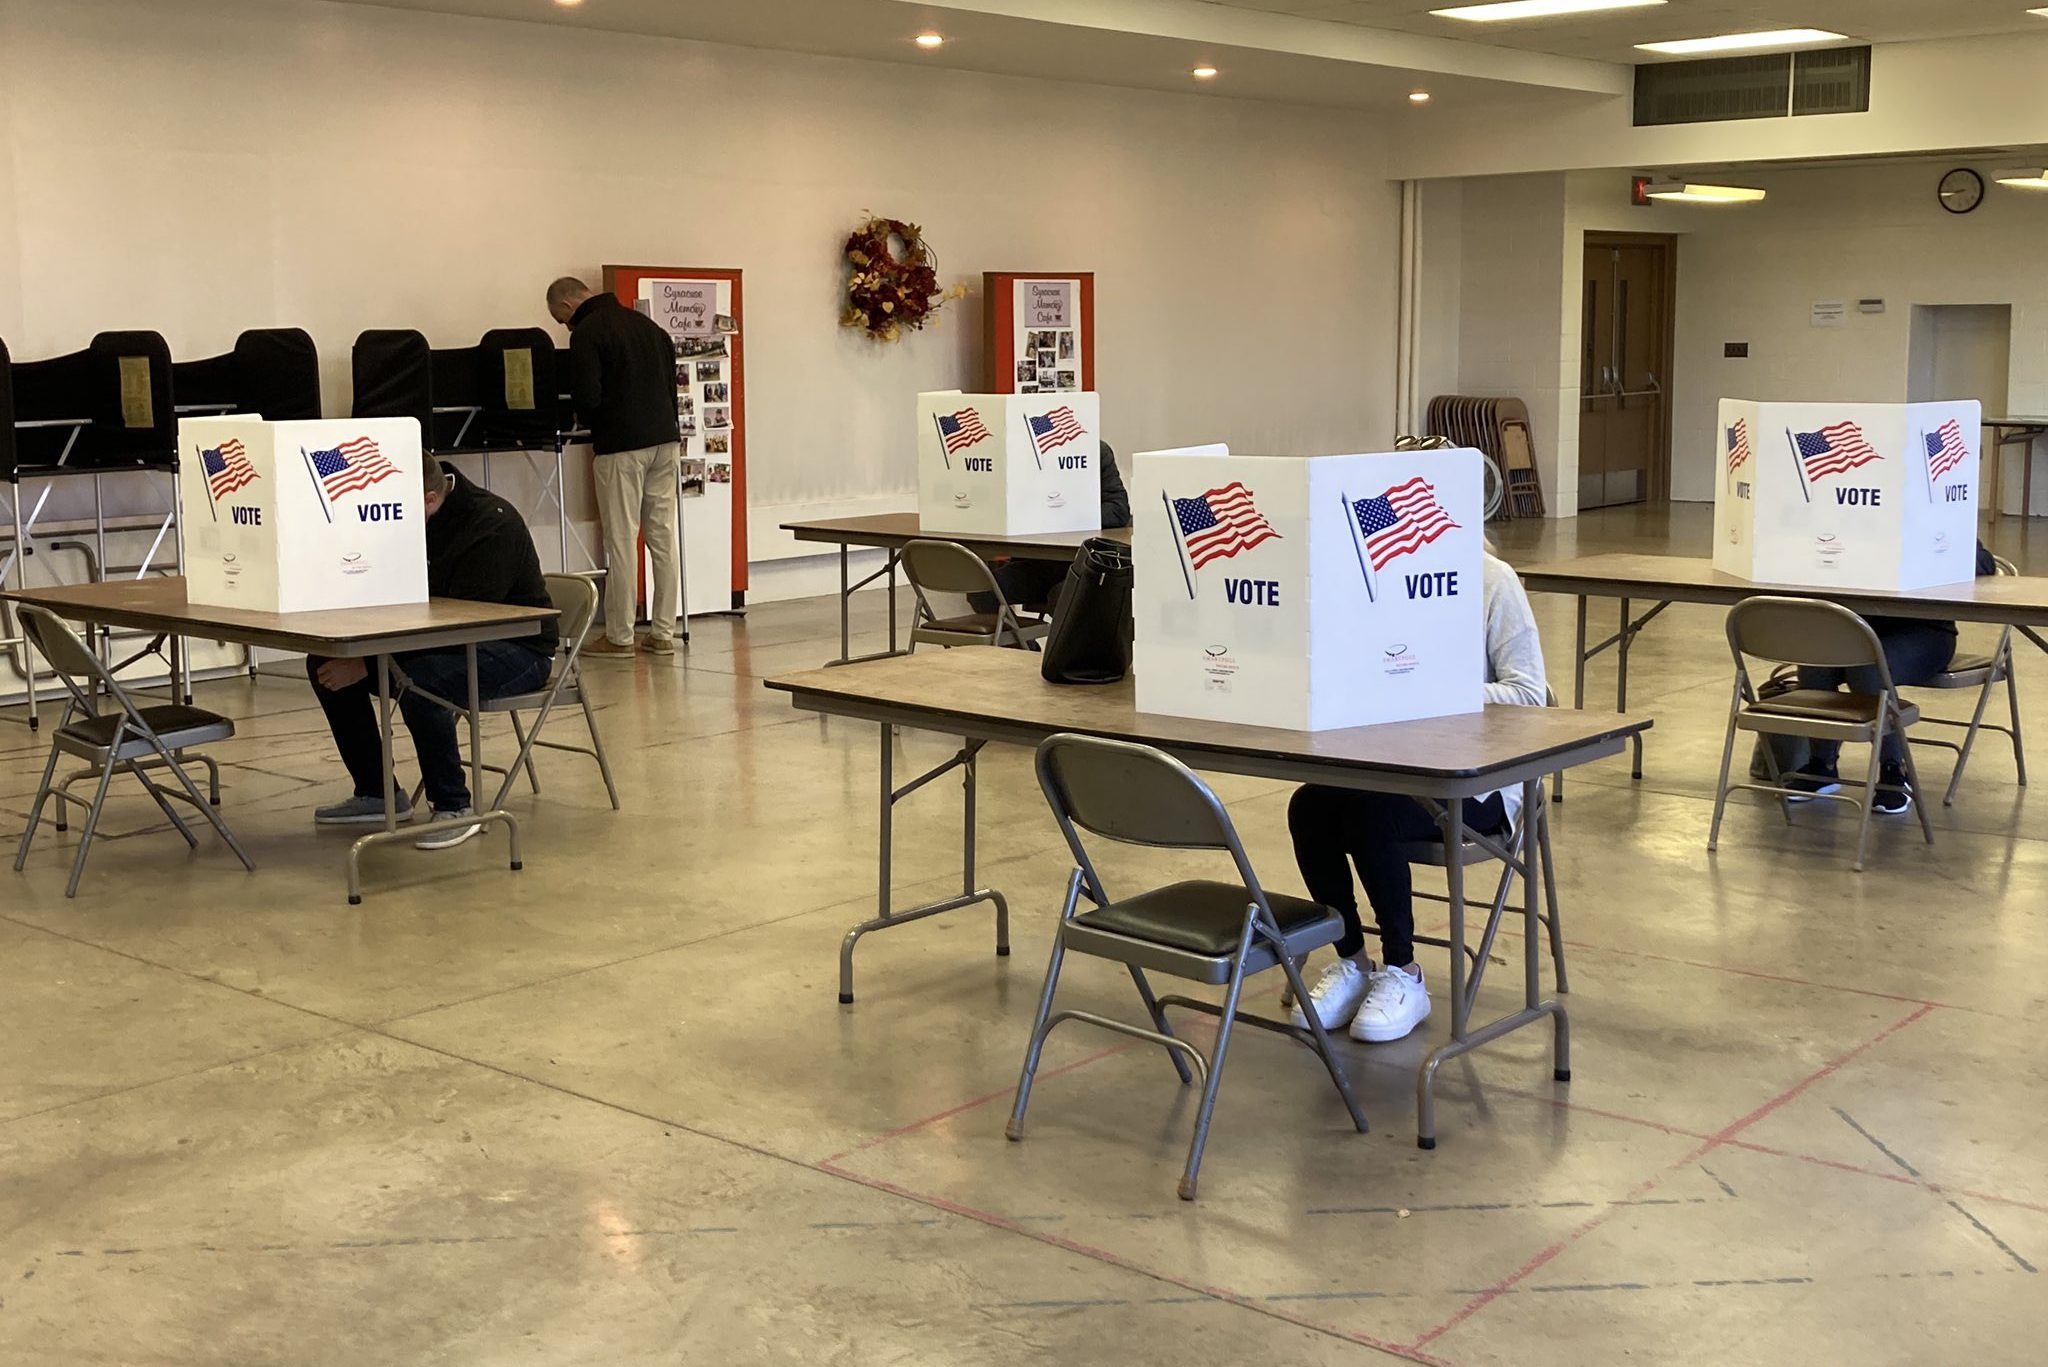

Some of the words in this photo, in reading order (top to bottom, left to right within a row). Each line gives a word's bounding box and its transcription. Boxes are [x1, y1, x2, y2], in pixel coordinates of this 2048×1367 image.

[664, 285, 702, 299] Syracuse
[664, 302, 705, 316] Memory
[965, 457, 993, 472] VOTE
[1058, 455, 1088, 470] VOTE
[1736, 481, 1750, 500] VOTE
[1835, 487, 1881, 506] VOTE
[1945, 483, 1968, 502] VOTE
[231, 506, 262, 526] VOTE
[357, 502, 403, 522] VOTE
[1224, 578, 1280, 607] VOTE
[1405, 571, 1459, 600] VOTE
